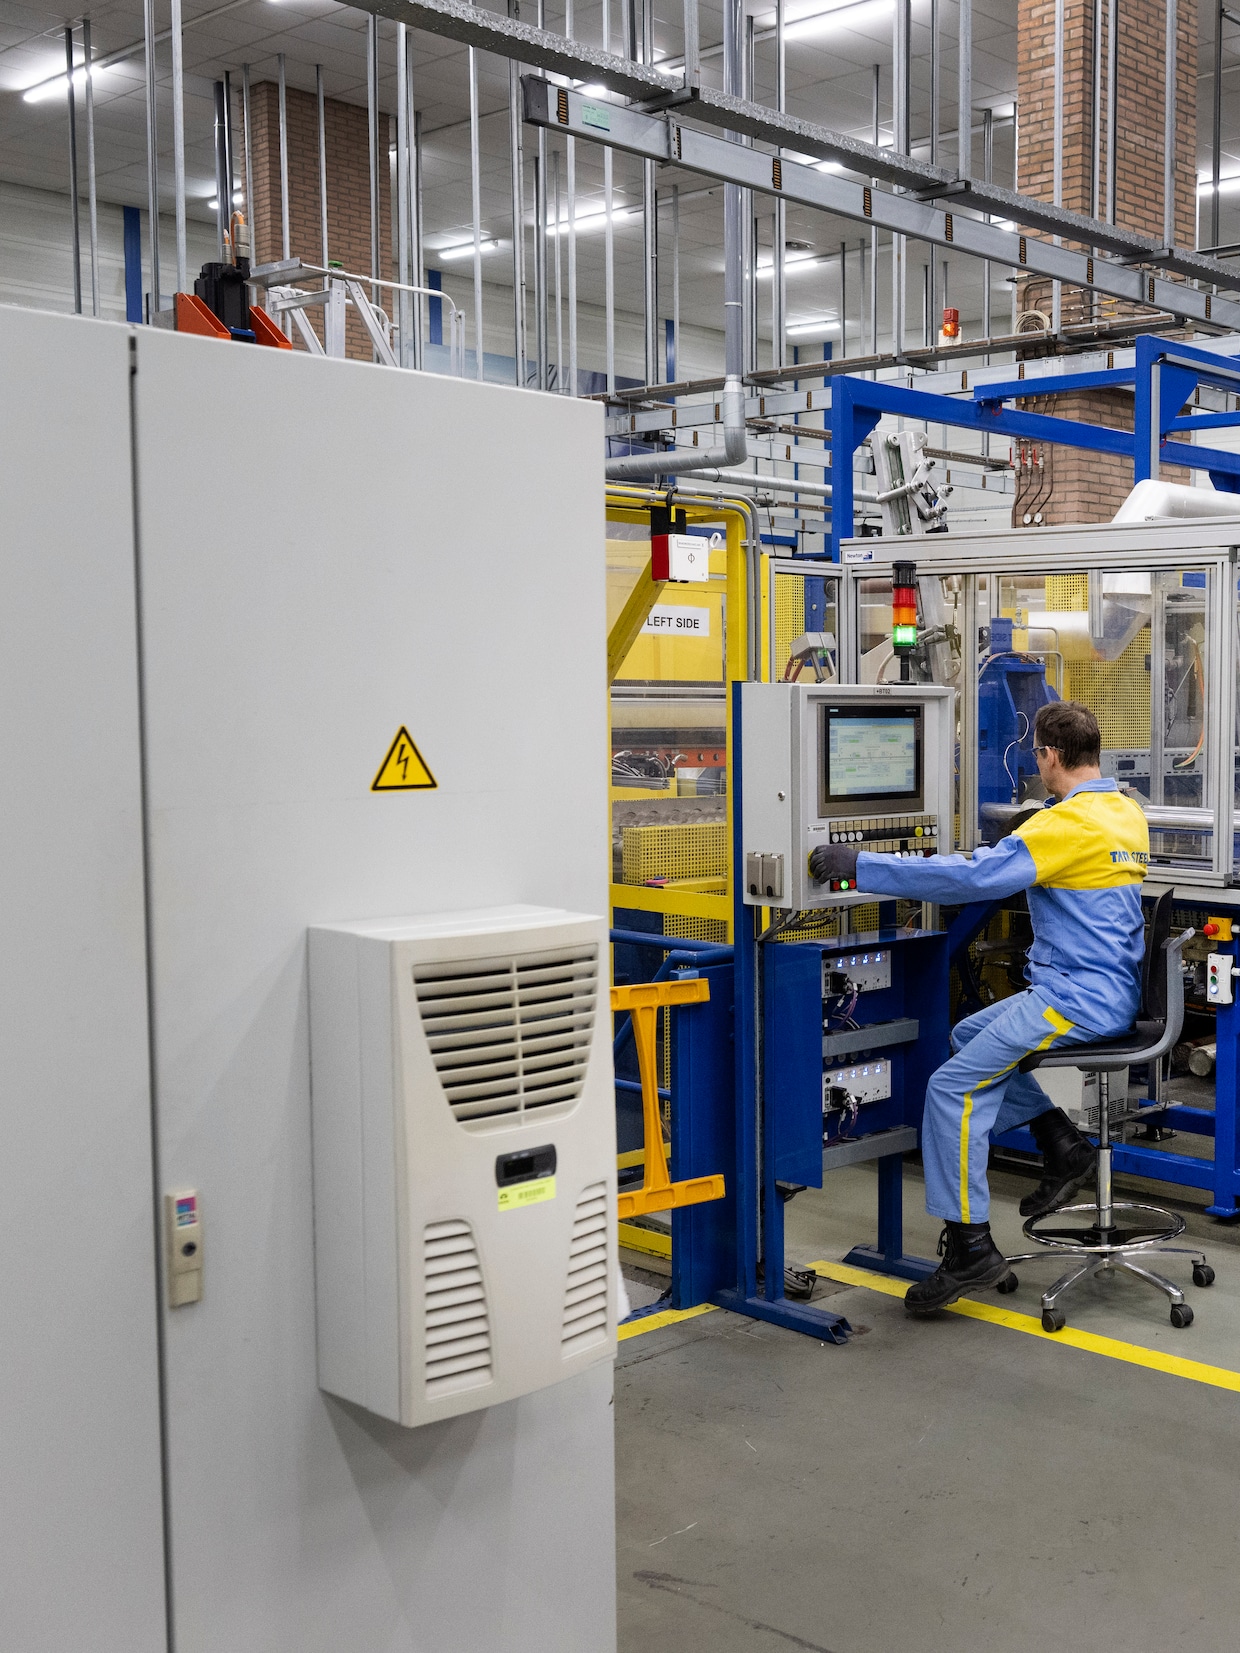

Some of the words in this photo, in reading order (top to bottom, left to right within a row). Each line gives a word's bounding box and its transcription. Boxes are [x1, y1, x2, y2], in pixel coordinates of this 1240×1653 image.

[647, 616, 673, 627] LEFT
[676, 617, 700, 629] SIDE
[1131, 851, 1149, 864] STEE
